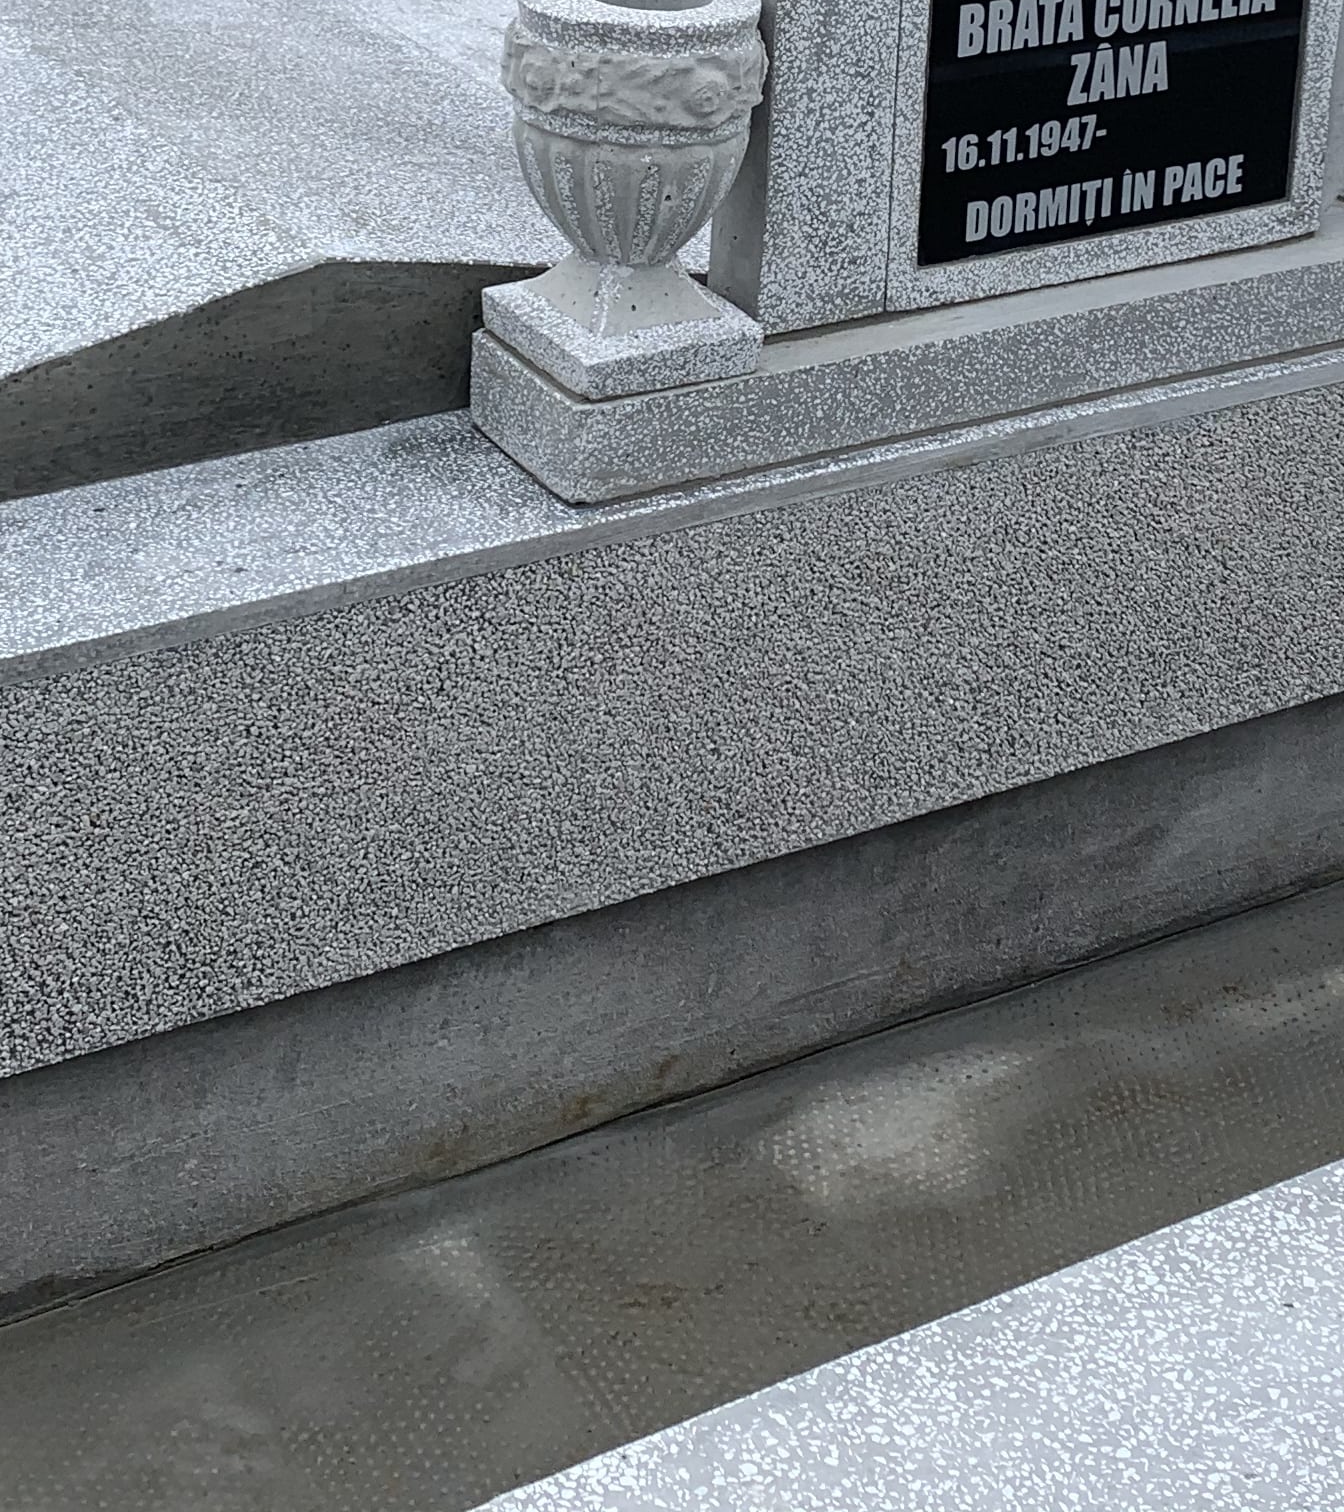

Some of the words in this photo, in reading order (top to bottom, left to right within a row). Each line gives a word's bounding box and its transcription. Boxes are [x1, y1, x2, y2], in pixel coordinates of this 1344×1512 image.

[1066, 41, 1169, 106] ZÂNA
[941, 114, 1107, 173] 16.11.1947-
[965, 177, 1113, 242] DORMIȚI
[1120, 168, 1156, 215] ÎN
[1163, 154, 1245, 207] PACE
